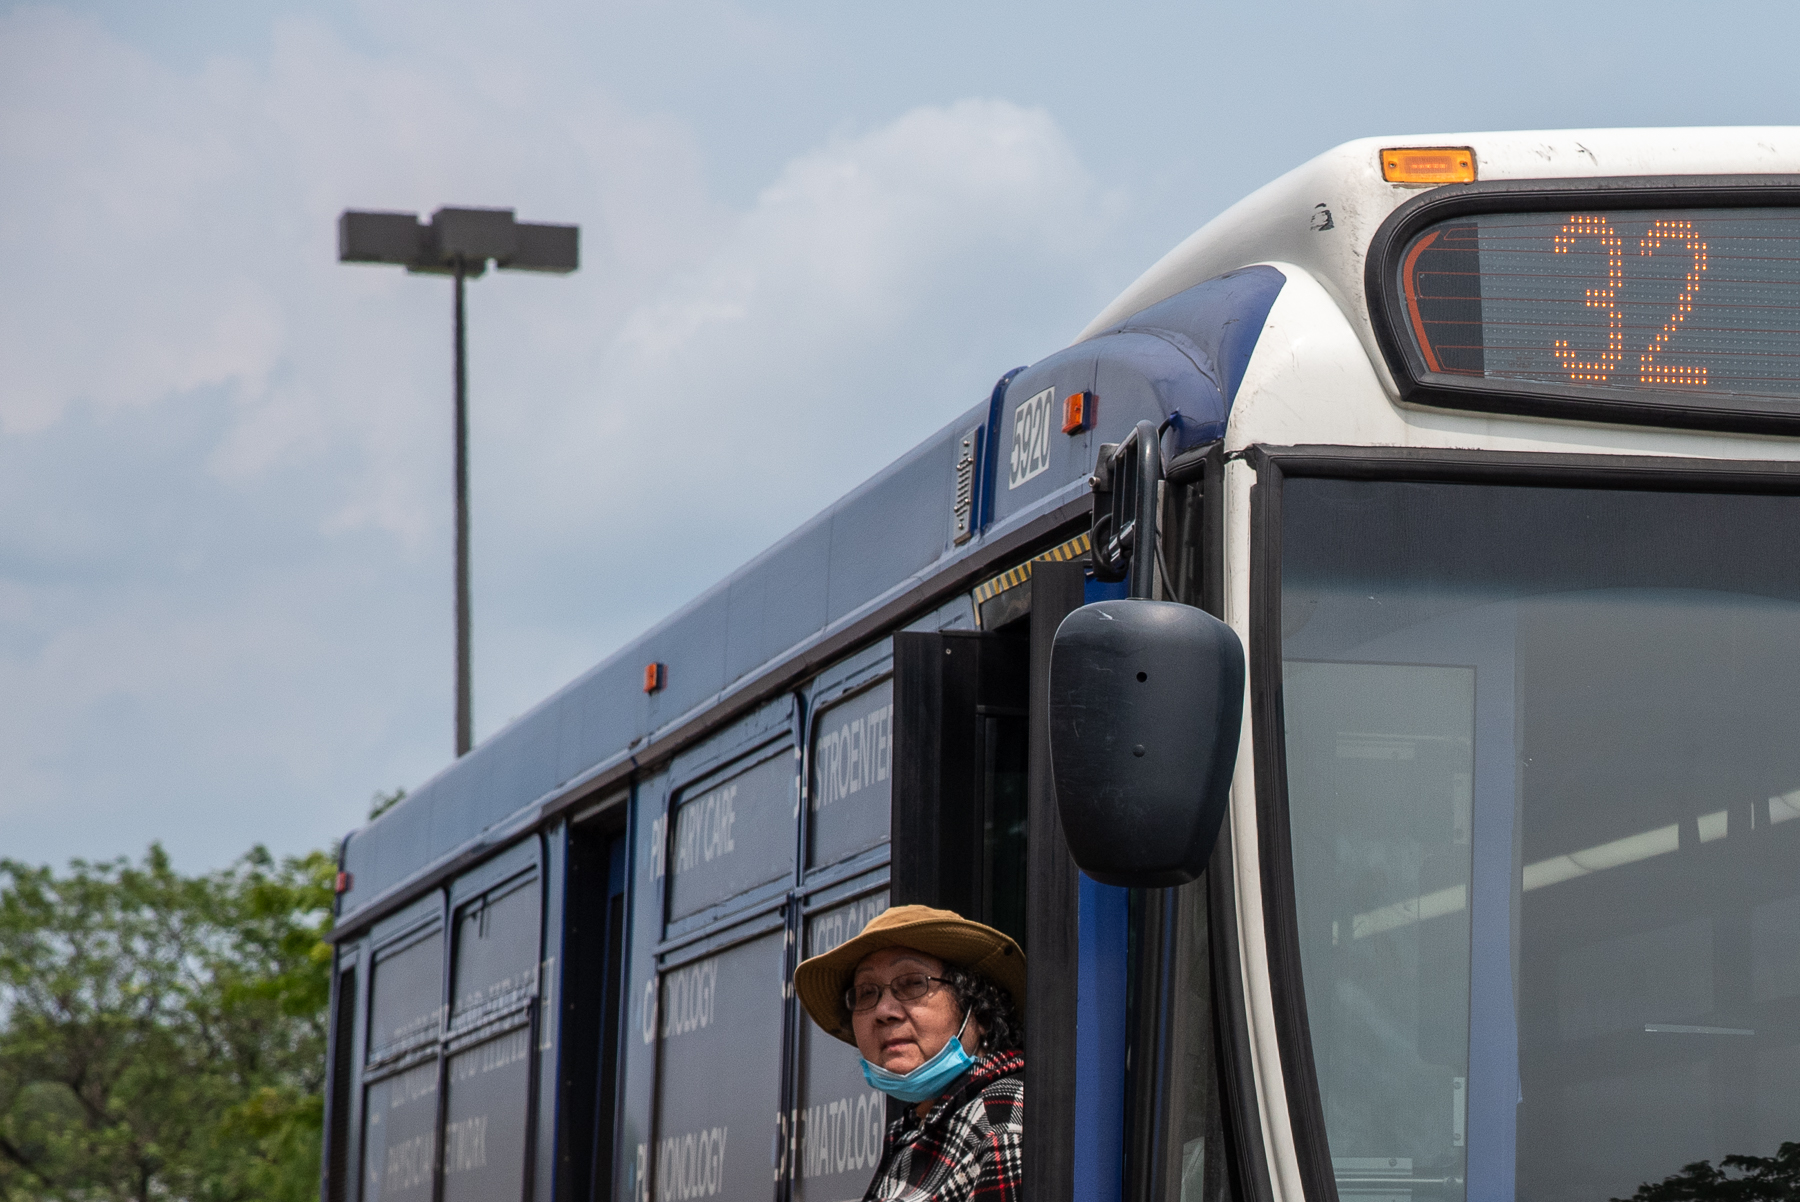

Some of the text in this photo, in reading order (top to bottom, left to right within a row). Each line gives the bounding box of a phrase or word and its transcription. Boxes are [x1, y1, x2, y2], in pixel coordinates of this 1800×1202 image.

[1554, 215, 1707, 384] 32
[1010, 390, 1054, 484] 5920
[704, 785, 737, 862] CARE
